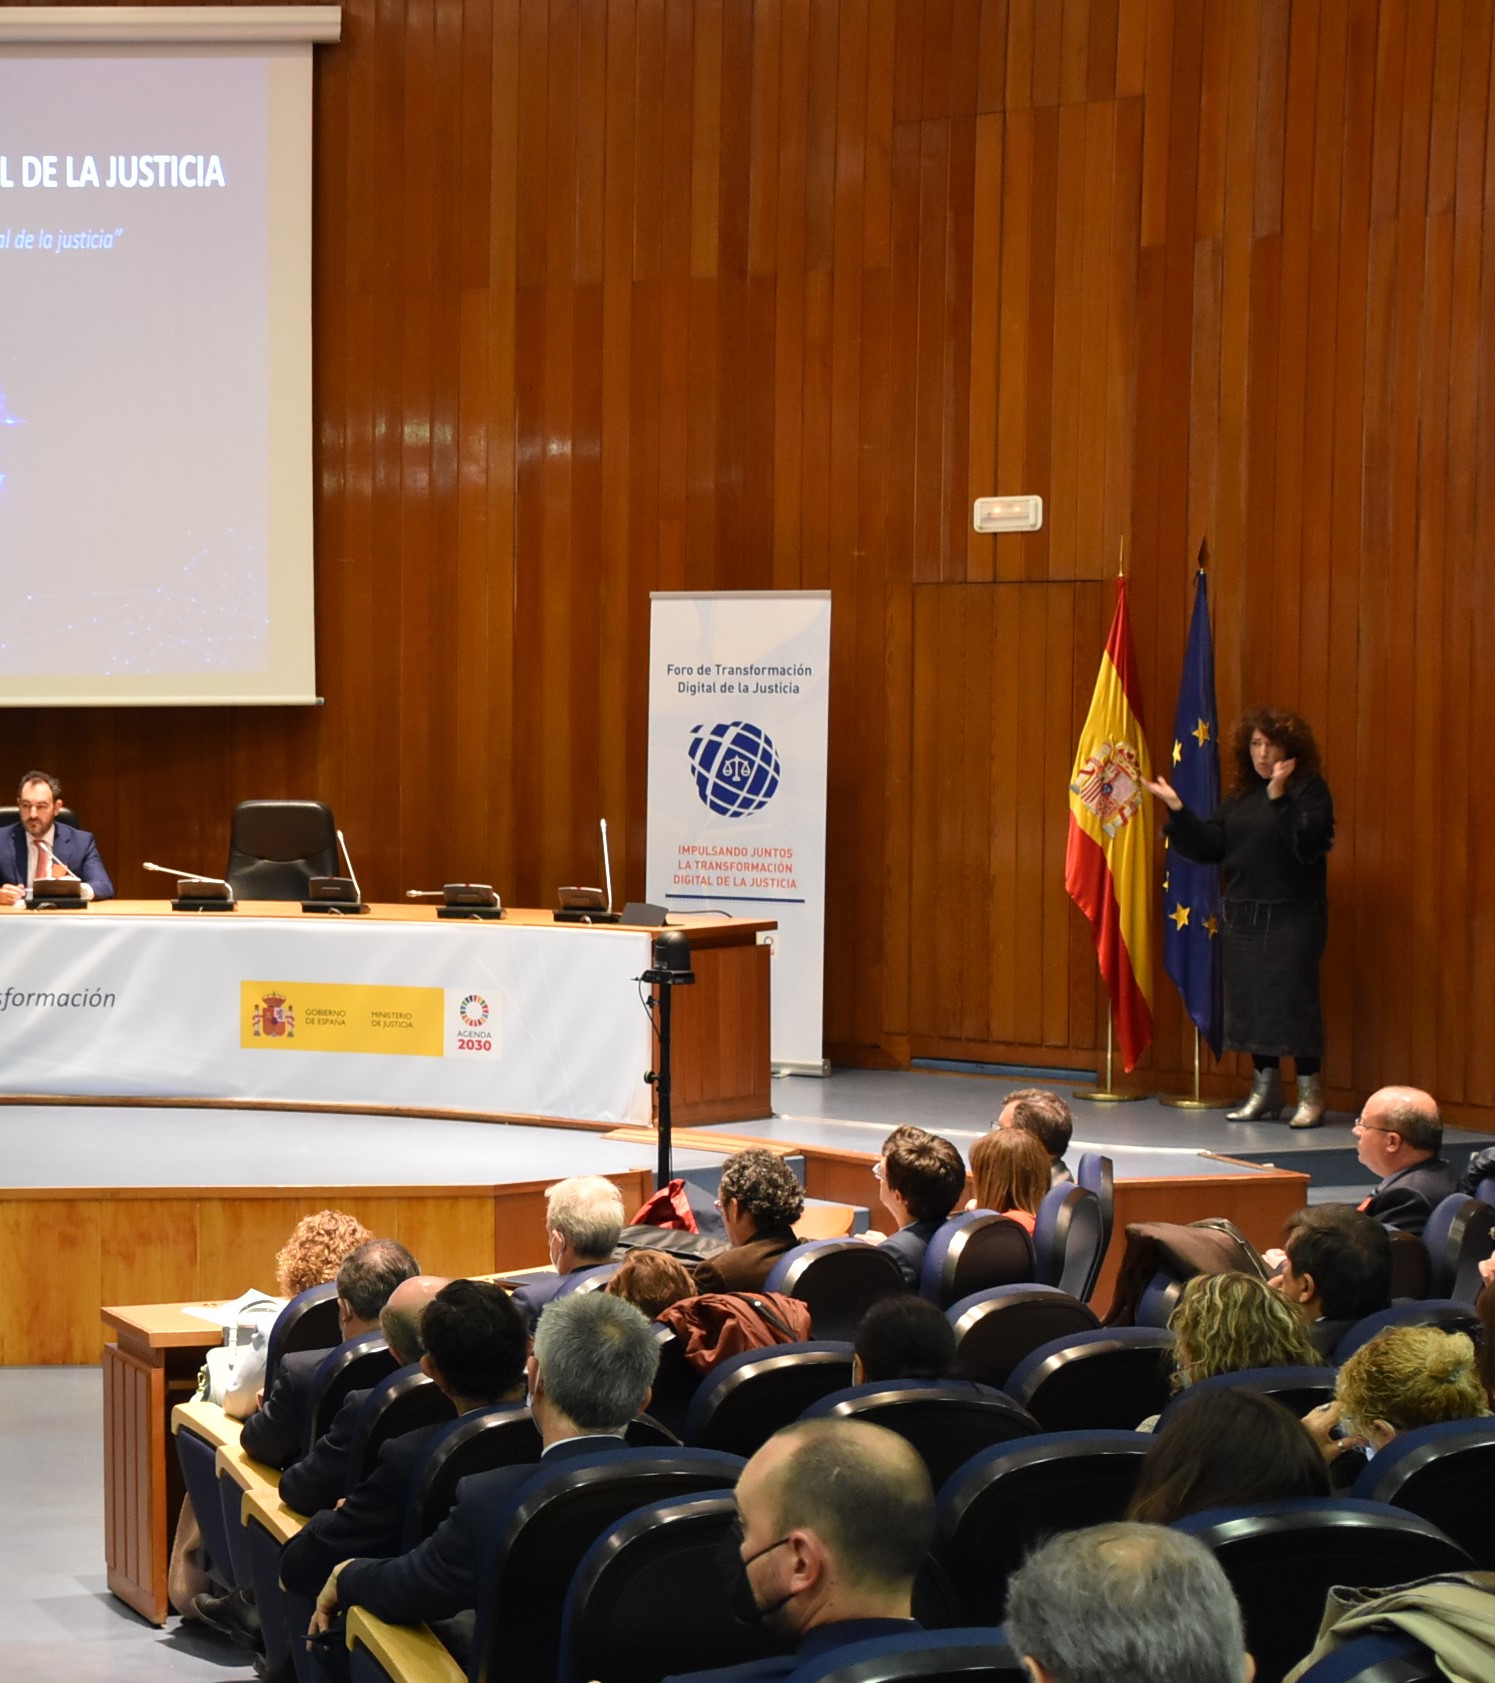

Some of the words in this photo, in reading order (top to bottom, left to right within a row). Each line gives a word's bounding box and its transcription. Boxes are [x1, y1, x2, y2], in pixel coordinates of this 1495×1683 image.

[22, 155, 58, 188] DE
[66, 155, 100, 188] LA
[105, 155, 226, 188] JUSTICIA
[14, 228, 35, 249] de
[39, 228, 53, 249] la
[667, 663, 694, 676] Foro
[697, 663, 712, 676] de
[715, 663, 812, 676] Transformación
[678, 681, 717, 696] Digital
[720, 682, 735, 694] de
[738, 682, 749, 694] la
[753, 682, 800, 694] Justicia
[678, 845, 748, 857] IMPULSANDO
[751, 847, 793, 858] JUNTOS
[678, 859, 692, 870] LA
[695, 860, 793, 874] TRANSFORMACIÓN
[673, 874, 713, 886] DIGITAL
[716, 876, 730, 886] DE
[733, 876, 747, 887] LA
[749, 877, 797, 889] JUSTICIA
[305, 1008, 346, 1017] GOBIERNO
[371, 1011, 412, 1020] MINISTERIO
[305, 1017, 316, 1025] DE
[318, 1017, 346, 1026] ESPAÑA
[383, 1020, 413, 1029] JUSTICIA
[457, 1030, 492, 1038] AGENDA
[457, 1039, 492, 1051] 2030
